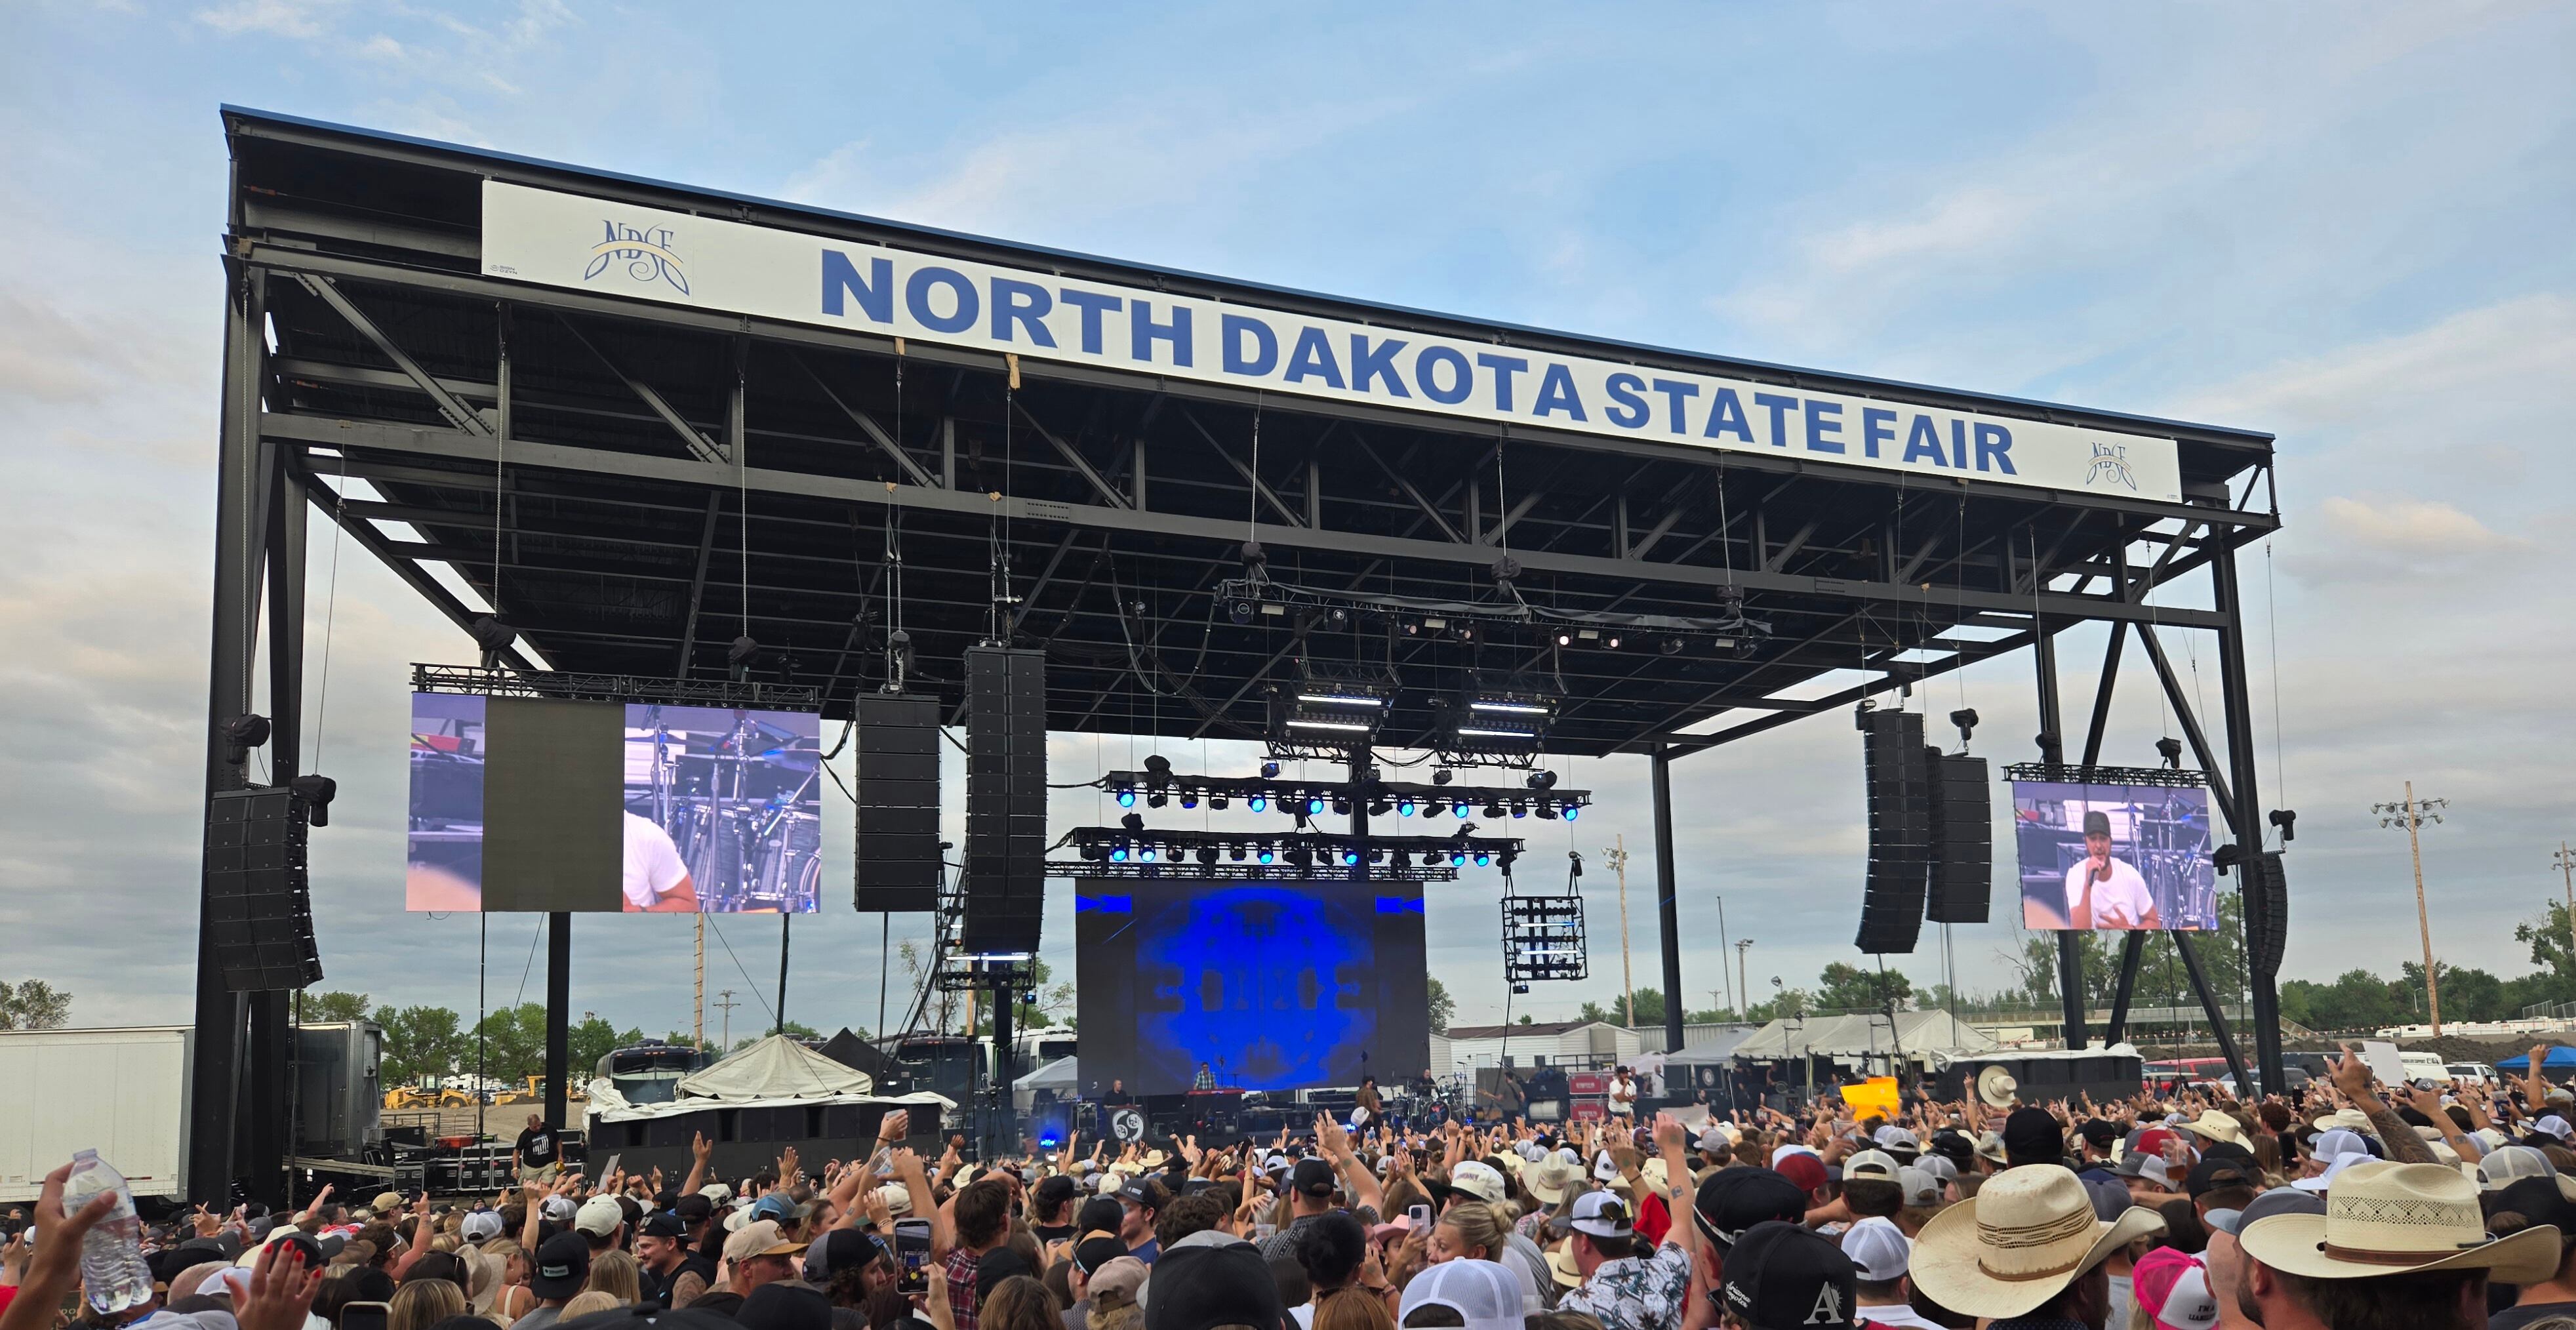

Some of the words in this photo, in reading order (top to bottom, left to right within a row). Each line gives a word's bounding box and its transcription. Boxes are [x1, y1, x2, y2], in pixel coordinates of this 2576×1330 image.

[822, 249, 1193, 368] NORTH
[1221, 313, 1588, 422] DAKOTA
[1605, 373, 1845, 455] STATE
[1862, 407, 2017, 475] FAIR
[1725, 1281, 1752, 1303] Arizona
